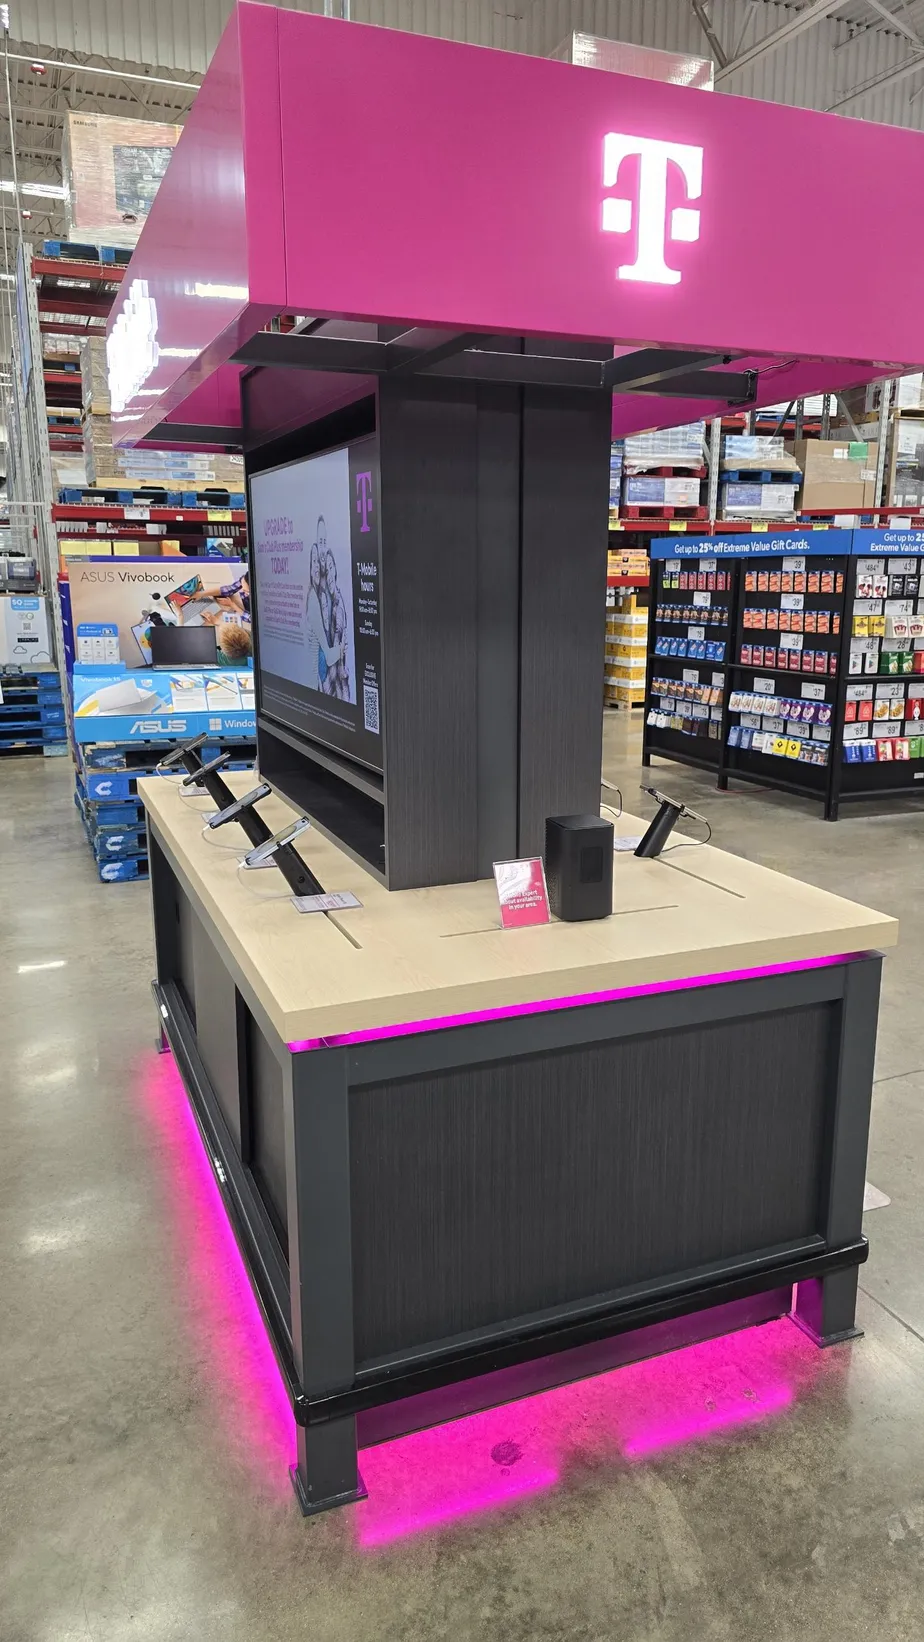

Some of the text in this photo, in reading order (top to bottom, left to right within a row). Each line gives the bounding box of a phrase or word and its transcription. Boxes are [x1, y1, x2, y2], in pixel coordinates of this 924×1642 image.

[602, 131, 704, 285] T
[356, 471, 372, 532] T
[884, 532, 897, 542] Get
[897, 534, 906, 544] up
[907, 534, 915, 542] to
[674, 538, 810, 556] Get up to 25% off Extreme Value Gift Cards.
[870, 542, 899, 552] Extreme
[900, 542, 920, 552] Value
[80, 571, 175, 583] ASUS Vivobook
[129, 720, 187, 734] ASUS
